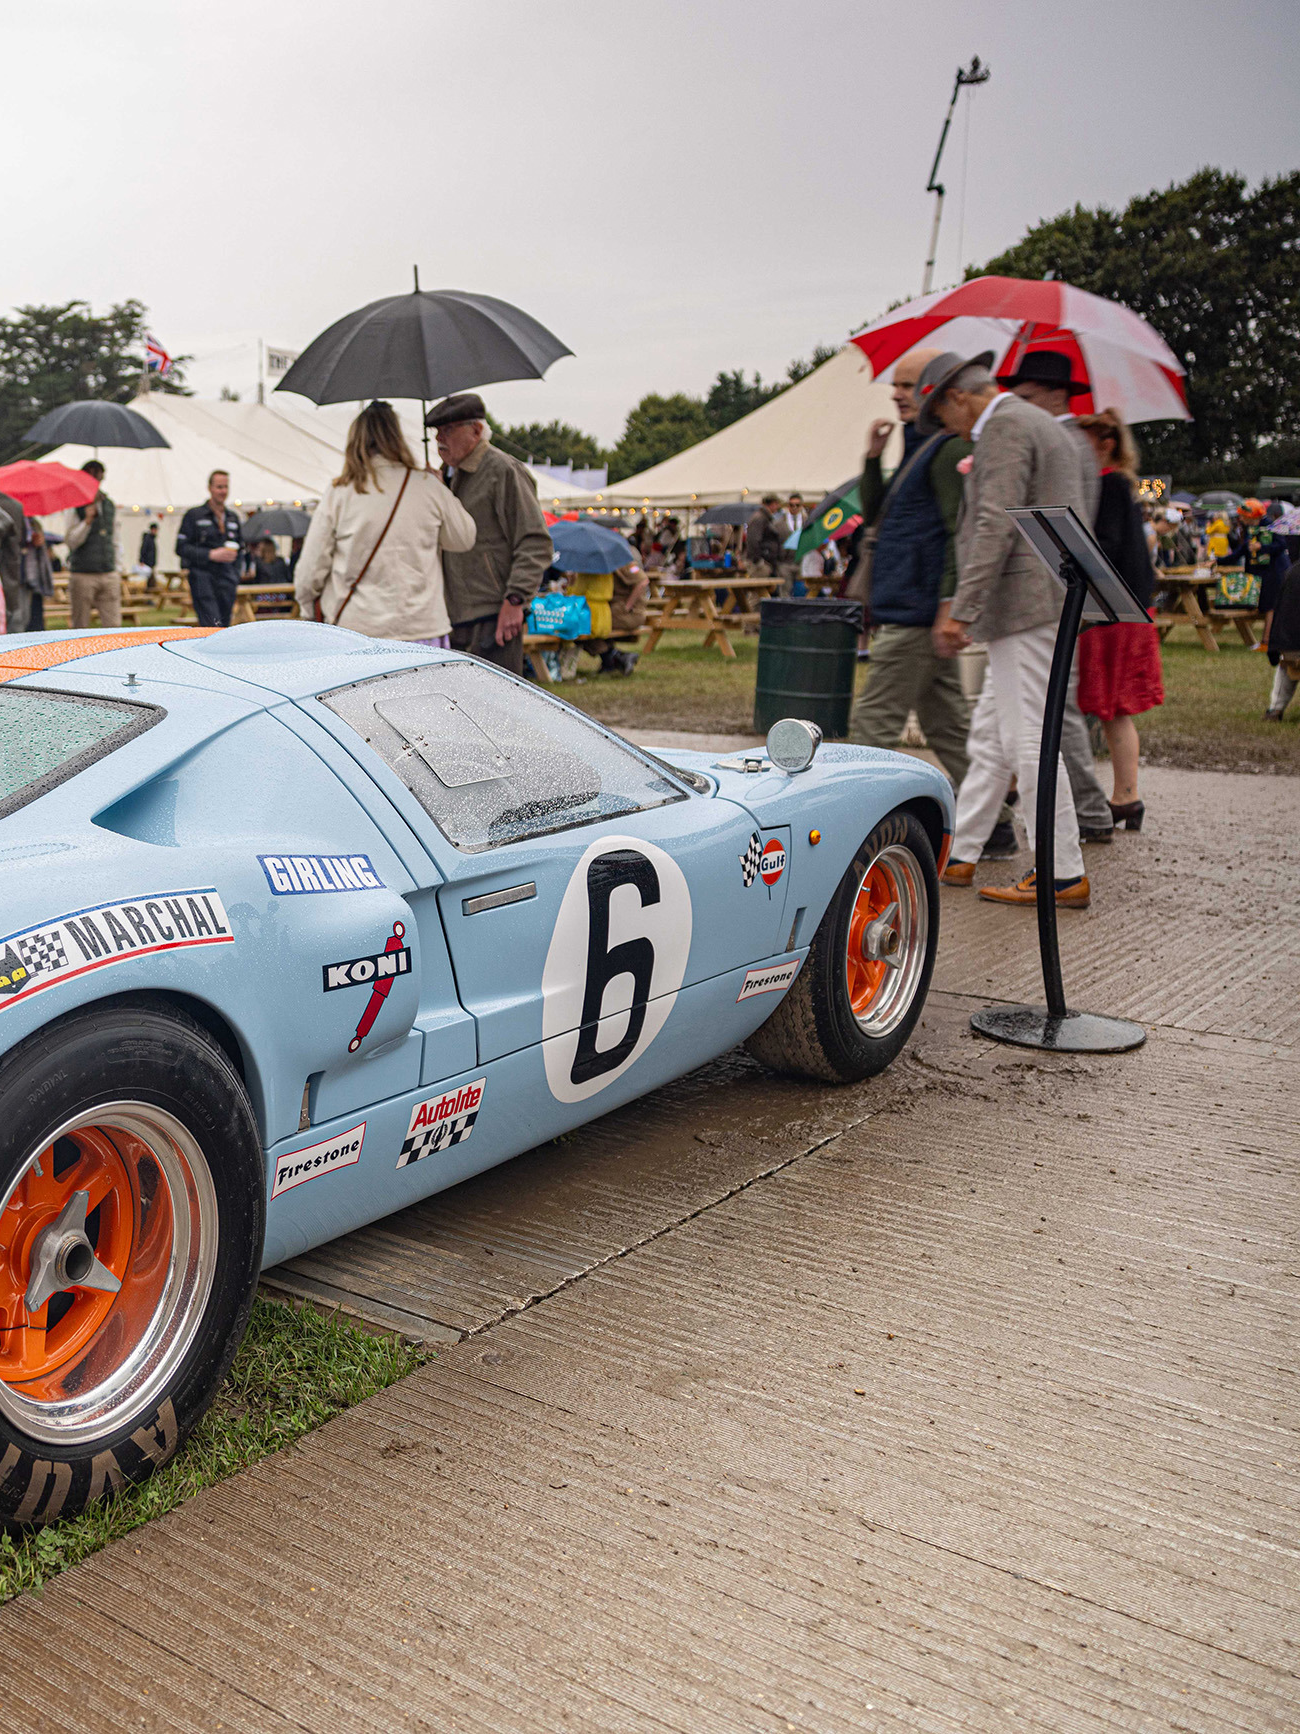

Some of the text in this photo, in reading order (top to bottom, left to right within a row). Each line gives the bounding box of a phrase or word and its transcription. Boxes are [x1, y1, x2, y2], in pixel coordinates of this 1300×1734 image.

[263, 857, 381, 892] GIRLING
[761, 854, 785, 871] Gulf
[63, 895, 228, 962] MARCHAL
[328, 951, 407, 988] KONI
[570, 848, 661, 1085] 6
[743, 971, 793, 994] Firestone
[28, 1069, 69, 1106] RADIAL
[411, 1085, 481, 1132] Autolite
[277, 1140, 360, 1186] Firestone
